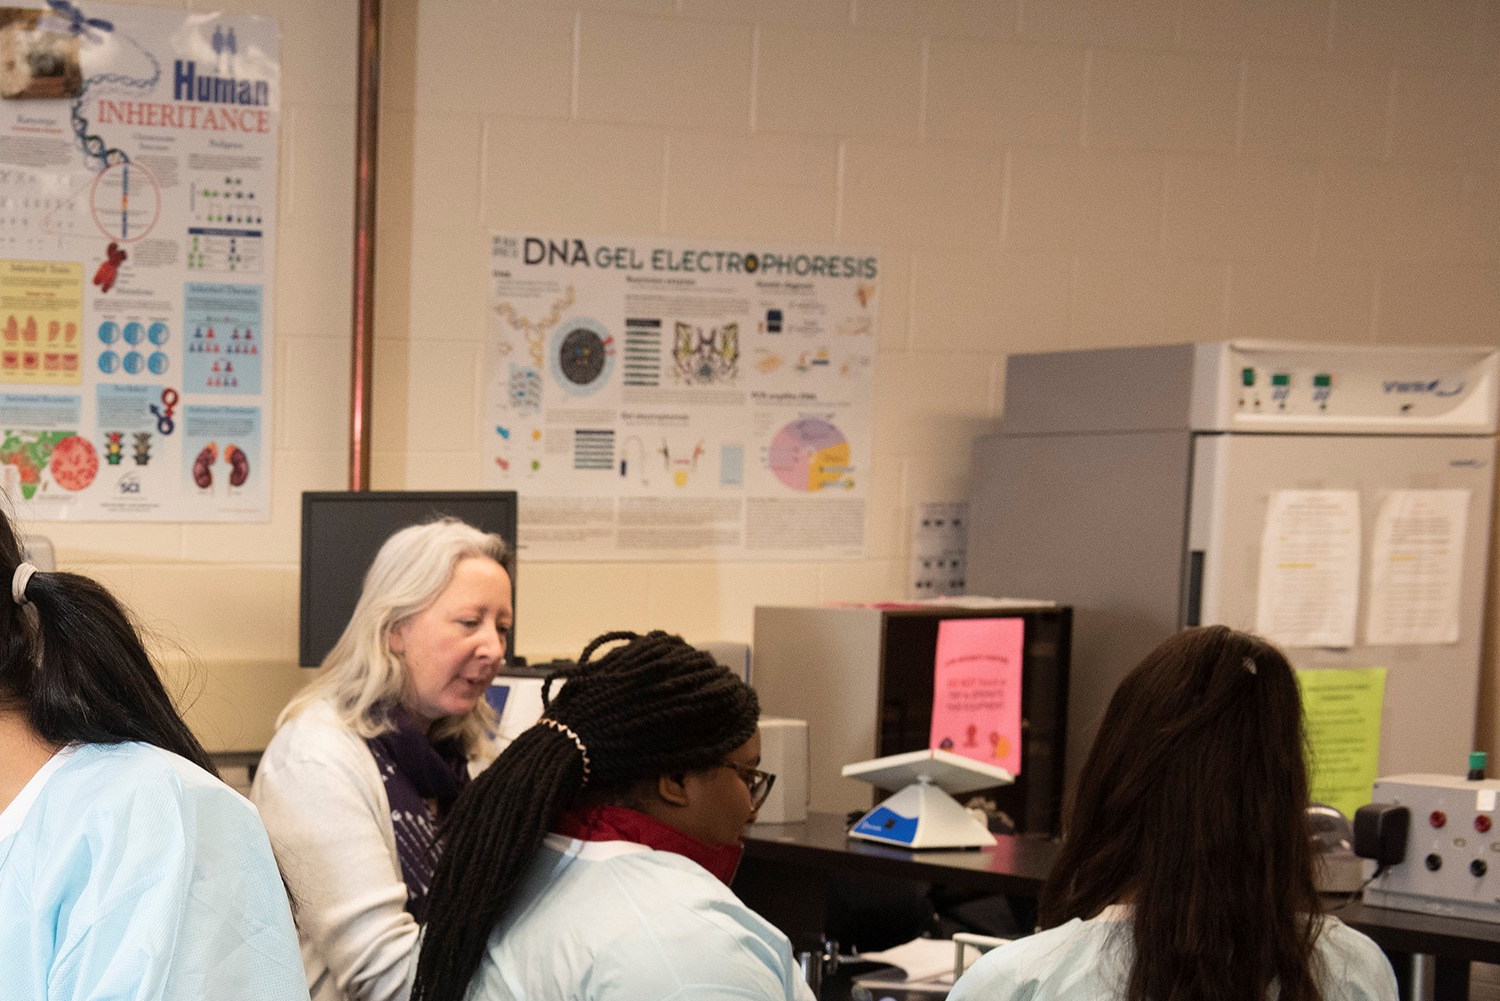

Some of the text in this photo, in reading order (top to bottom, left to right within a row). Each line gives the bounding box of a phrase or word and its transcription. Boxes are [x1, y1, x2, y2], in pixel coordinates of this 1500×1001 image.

[174, 60, 269, 106] Human
[98, 100, 271, 134] INHERITANCE
[524, 236, 590, 267] DNA
[594, 246, 644, 270] GEL
[651, 248, 878, 279] ELECTROPHORESIS
